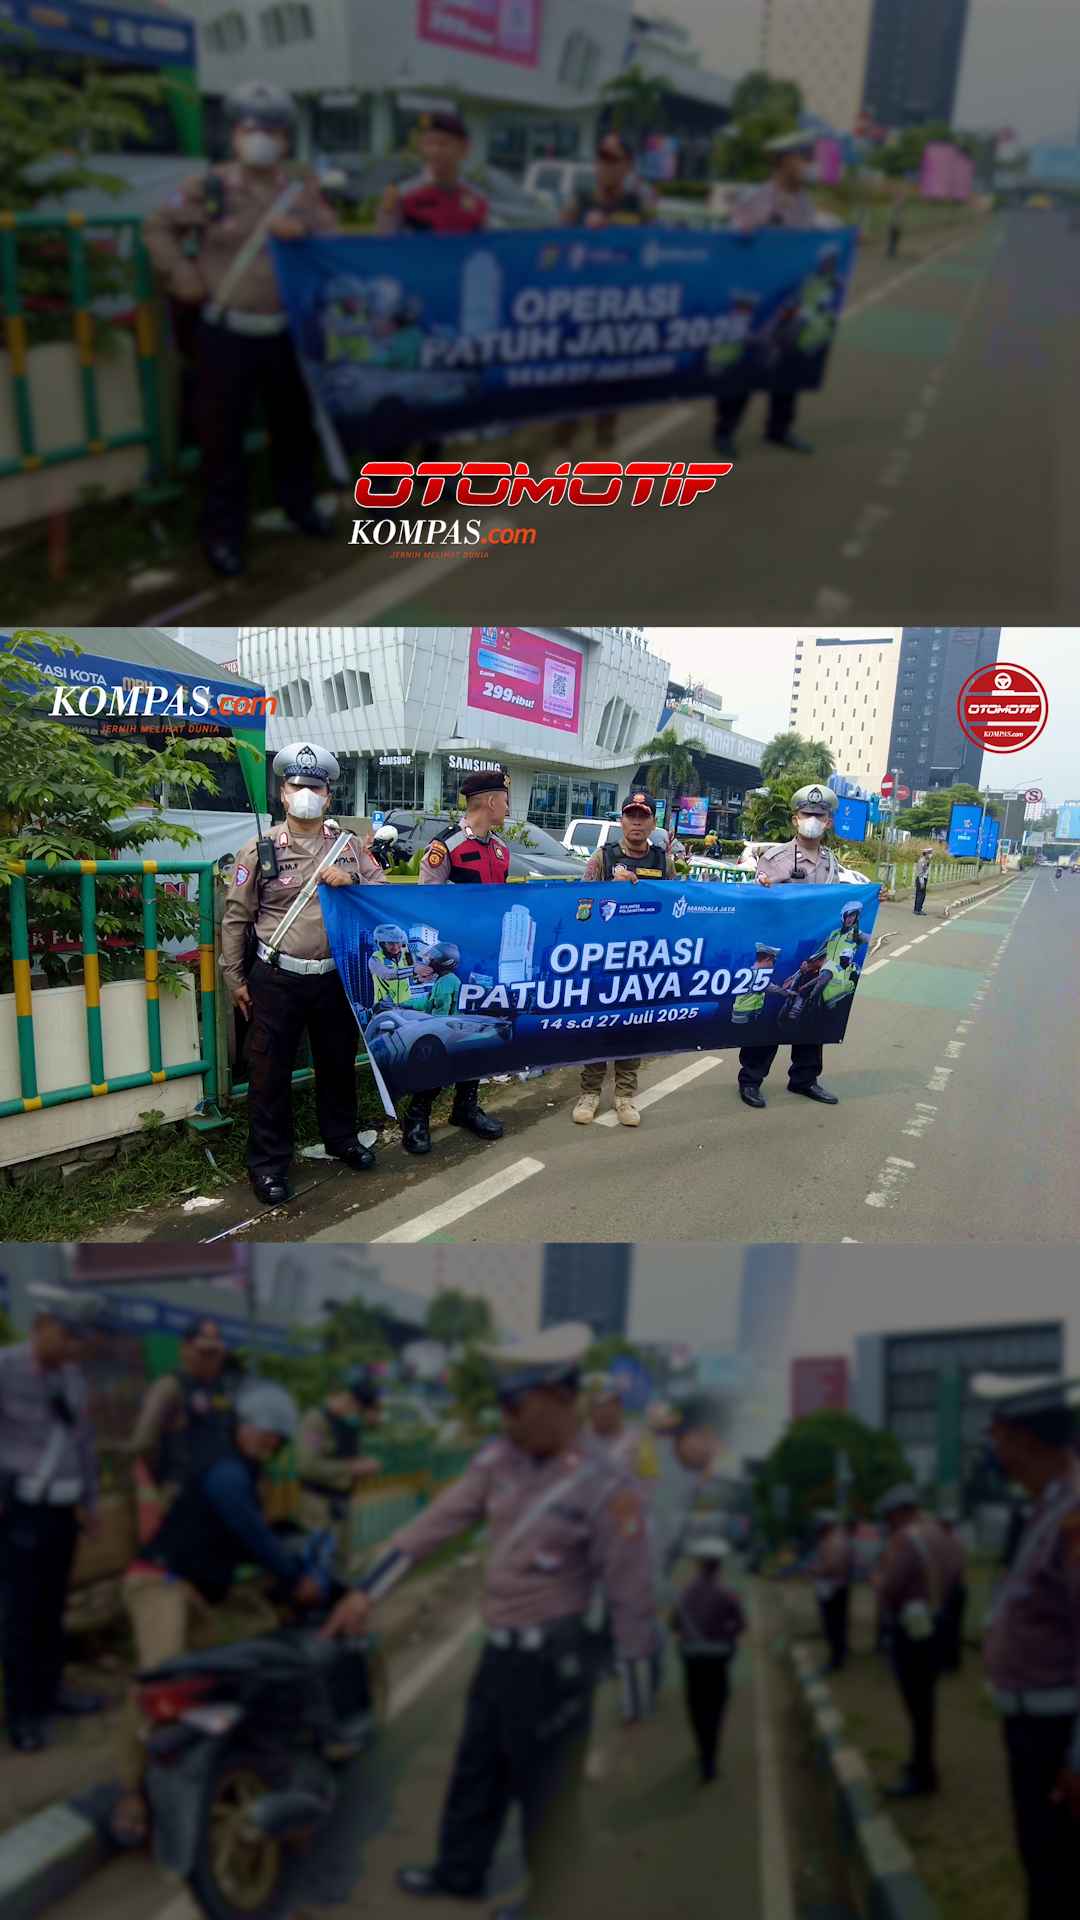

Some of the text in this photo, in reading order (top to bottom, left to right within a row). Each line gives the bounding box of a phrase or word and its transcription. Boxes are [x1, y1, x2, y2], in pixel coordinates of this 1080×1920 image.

[513, 284, 682, 323] OPERASI
[422, 327, 560, 369] PATUH
[566, 320, 658, 356] JAYA
[70, 669, 107, 686] KOTA
[379, 755, 412, 766] SAMSUNG
[448, 755, 501, 773] SAMSUNG
[550, 938, 704, 974] OPERASI
[458, 968, 774, 1010] PATUH JAYA 2025
[541, 1007, 699, 1030] 14 s.d 27 Juli 2025
